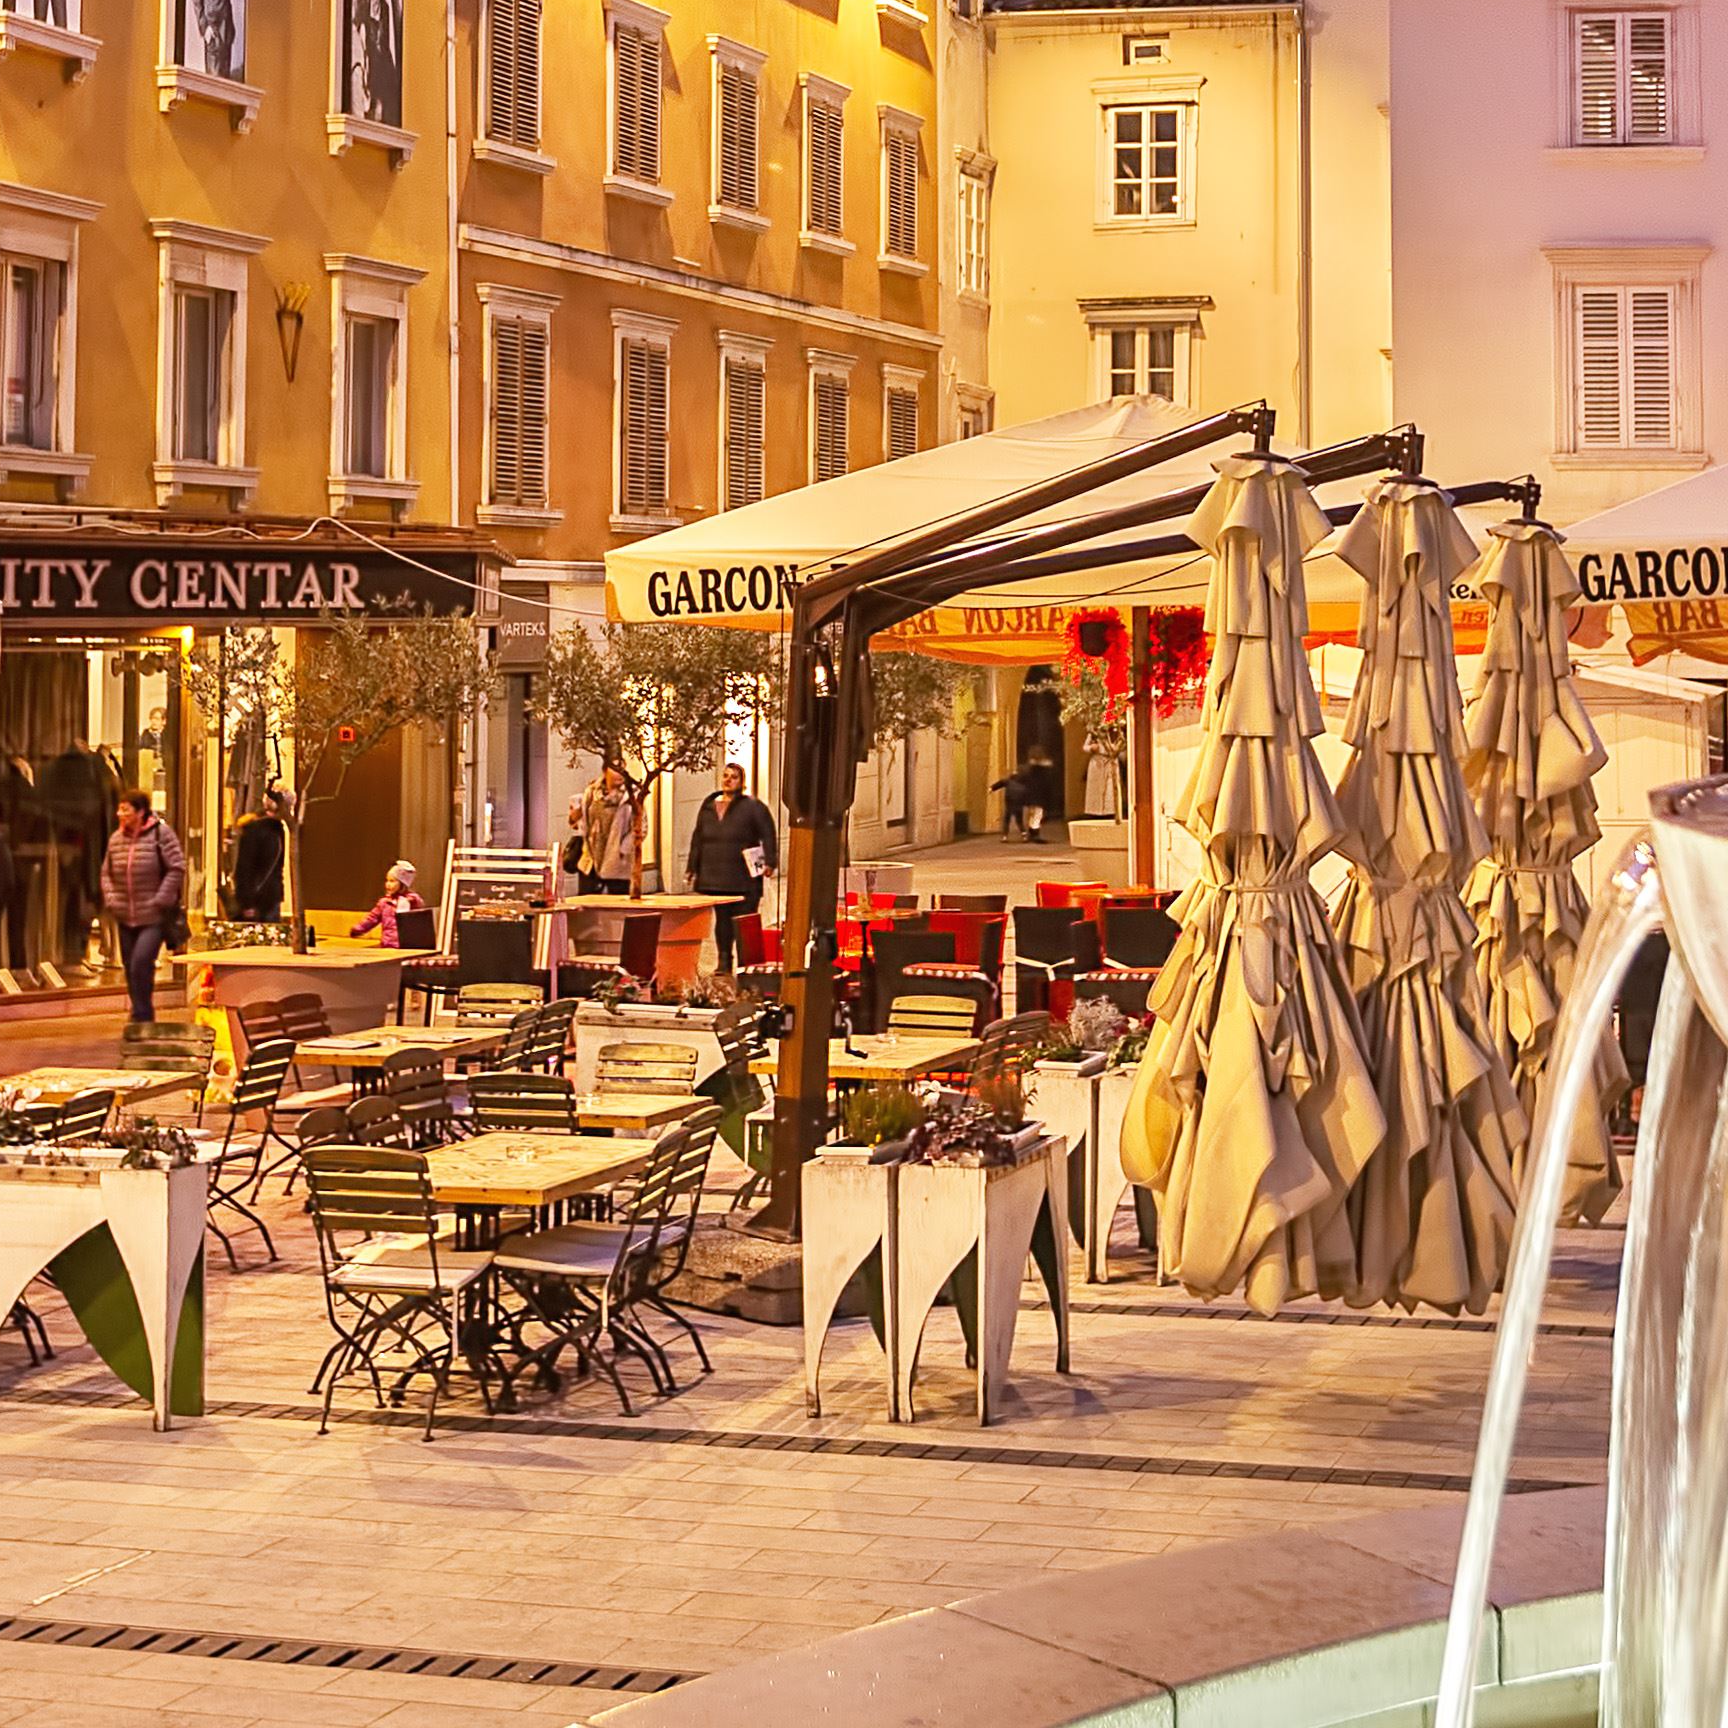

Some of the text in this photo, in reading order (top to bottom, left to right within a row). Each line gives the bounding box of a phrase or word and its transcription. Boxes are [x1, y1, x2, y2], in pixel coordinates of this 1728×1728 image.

[130, 560, 366, 610] CENTAR
[648, 563, 799, 617] GARCON
[500, 621, 547, 637] VARTEKS
